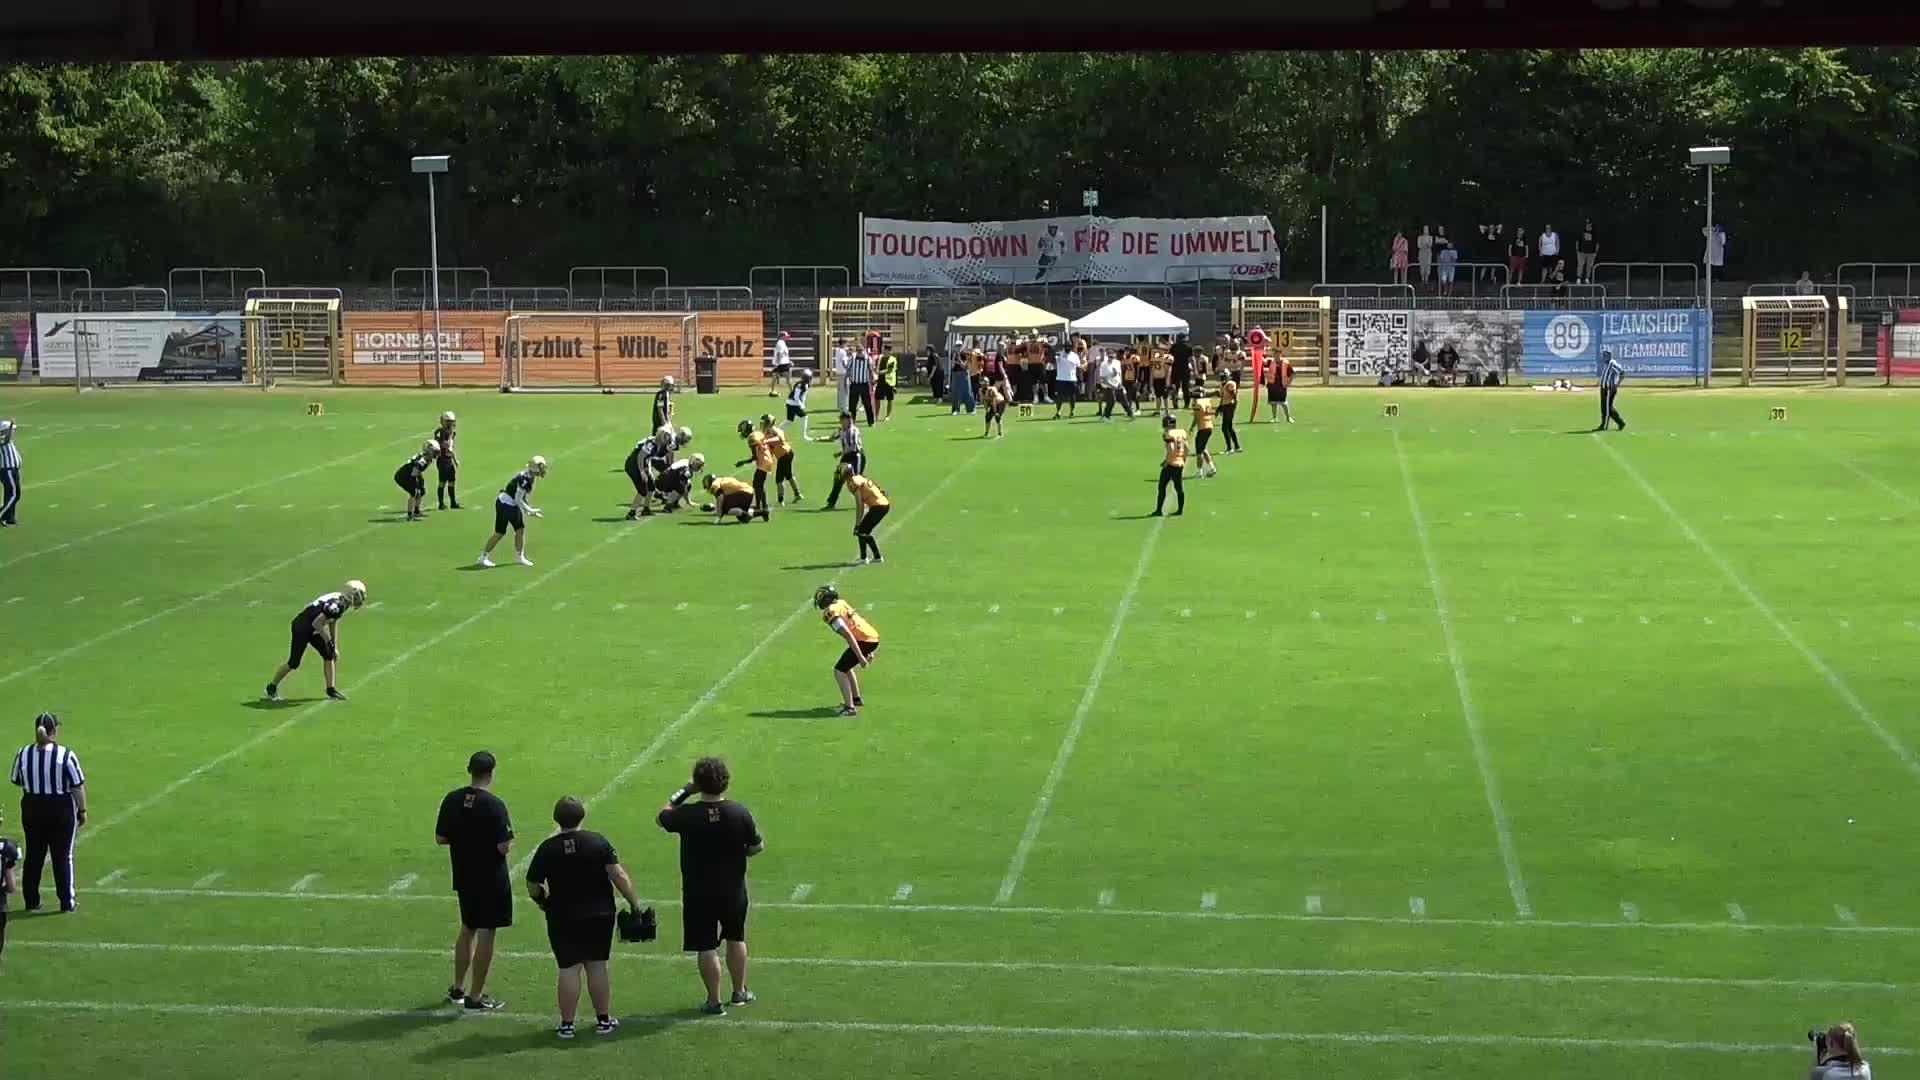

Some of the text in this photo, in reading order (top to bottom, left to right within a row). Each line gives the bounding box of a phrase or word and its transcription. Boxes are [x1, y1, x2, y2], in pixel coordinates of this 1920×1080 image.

[865, 232, 1028, 260] TOUCHDOWN
[1122, 231, 1159, 254] DIE
[1601, 313, 1689, 335] TEAMSHOP
[285, 331, 301, 348] 15
[355, 332, 460, 349] HORNBACH
[1273, 330, 1290, 348] 13
[1553, 321, 1582, 350] 89
[1783, 332, 1800, 348] 12
[495, 335, 583, 358] Herzblut
[616, 335, 668, 358] Wille
[702, 335, 754, 358] Stolz
[1618, 342, 1689, 358] TEAMBANDE
[307, 404, 320, 415] 30
[1384, 405, 1398, 416] 40
[1771, 408, 1785, 420] 30
